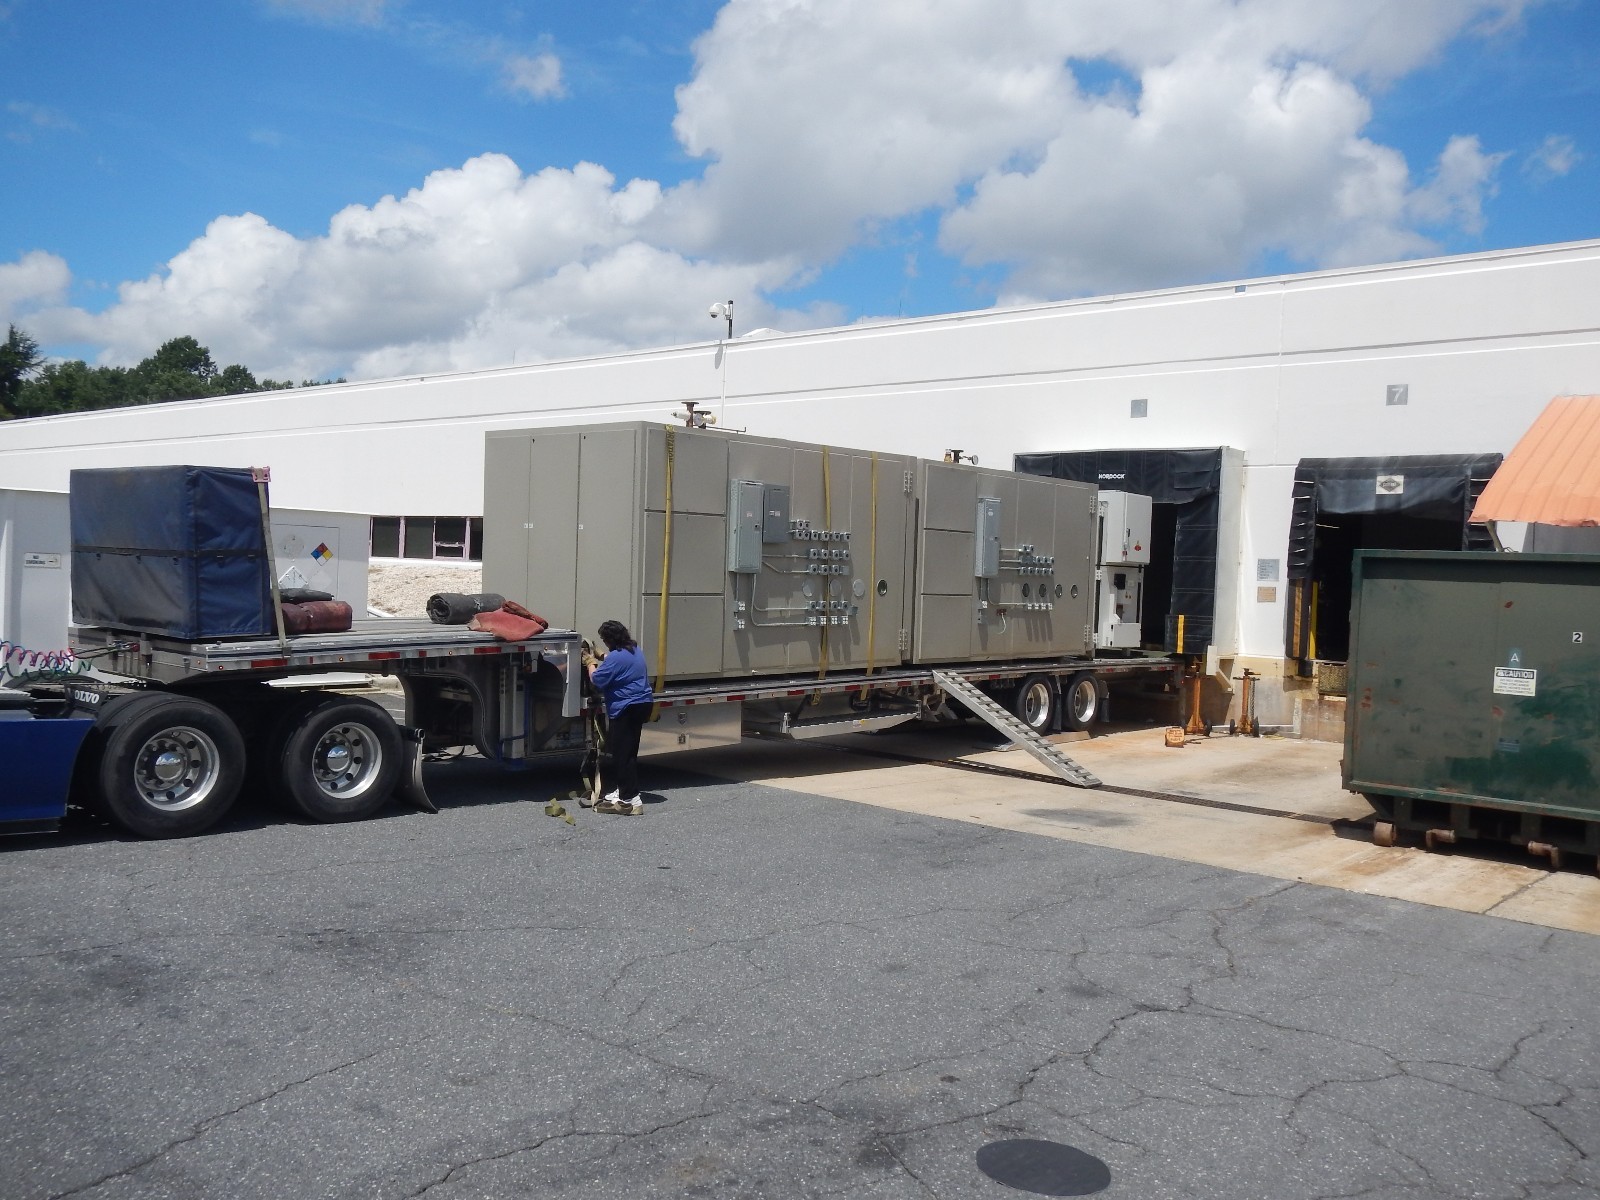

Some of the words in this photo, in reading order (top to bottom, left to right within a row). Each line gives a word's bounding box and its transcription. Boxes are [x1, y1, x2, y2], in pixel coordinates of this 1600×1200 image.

[1391, 388, 1403, 402] 7
[1574, 632, 1581, 642] 2
[1510, 653, 1519, 662] A
[1504, 670, 1534, 679] CAUTION
[74, 690, 100, 704] OLVO
